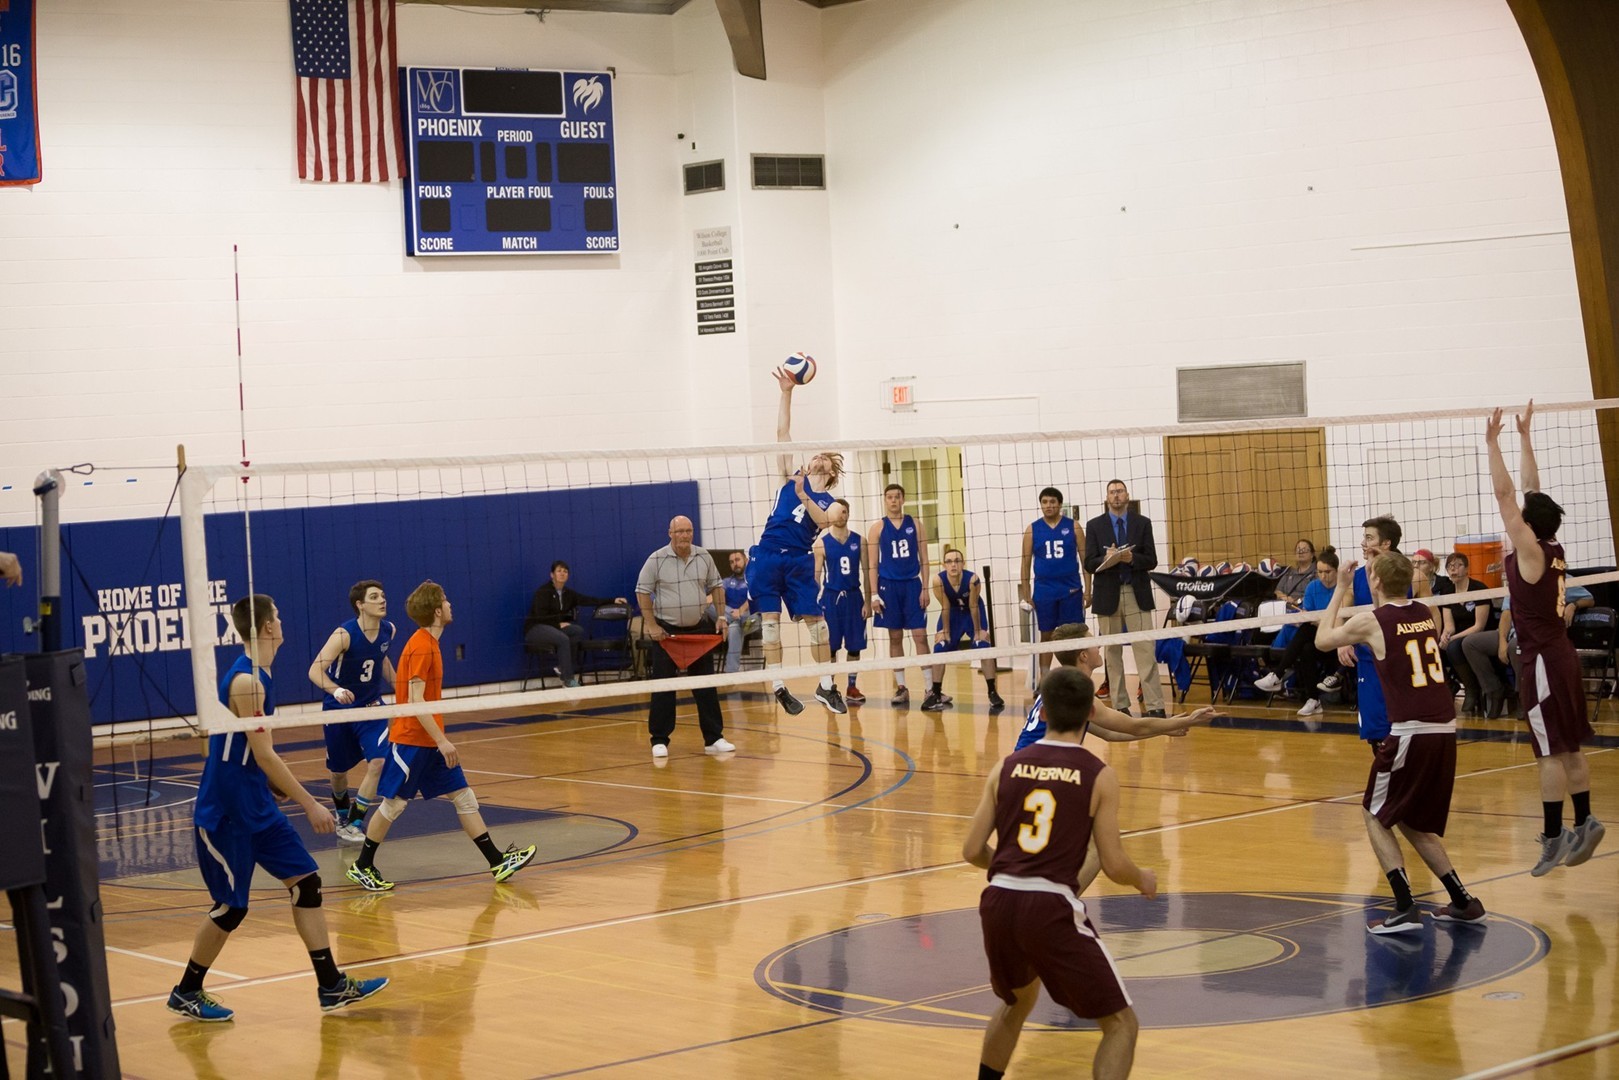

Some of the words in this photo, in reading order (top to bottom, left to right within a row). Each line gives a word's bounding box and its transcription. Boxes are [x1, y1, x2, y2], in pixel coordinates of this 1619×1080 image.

[418, 118, 483, 137] PHOENIX
[497, 130, 533, 143] PERIOD
[560, 121, 606, 139] GUEST
[418, 186, 452, 198] FOULS
[487, 186, 525, 198] PLAYER
[528, 186, 554, 198] FOUL
[583, 186, 614, 198] FOULS
[420, 237, 453, 250] SCORE
[502, 237, 537, 249] MATCH
[586, 236, 617, 248] SCORE
[893, 386, 909, 403] EXIT
[791, 504, 806, 524] 4
[891, 539, 910, 558] 12
[1045, 540, 1064, 559] 15
[840, 556, 851, 575] 9
[1176, 580, 1215, 591] molten
[97, 586, 152, 612] HOME
[157, 583, 182, 606] OF
[207, 580, 227, 603] HE
[82, 604, 245, 658] PHOEIX
[1396, 618, 1435, 635] ALVERNI
[359, 659, 375, 682] 3
[1405, 636, 1445, 687] 13
[1010, 763, 1082, 785] ALVERNIA
[1017, 788, 1057, 854] 3
